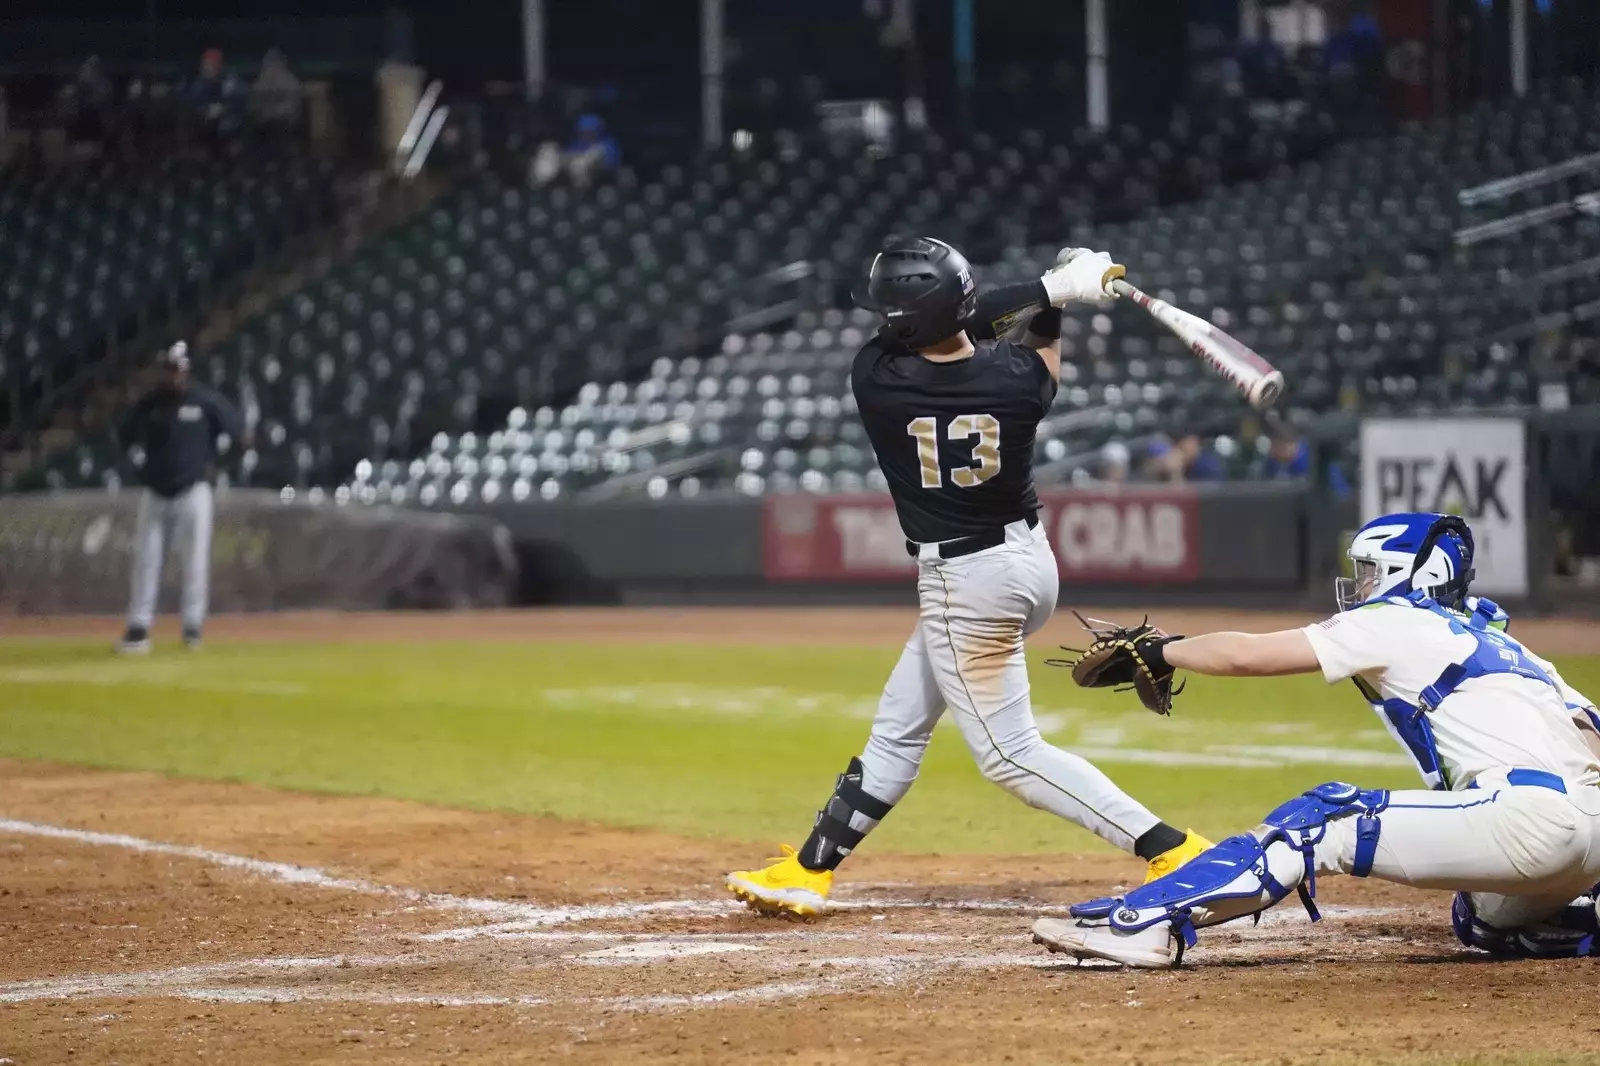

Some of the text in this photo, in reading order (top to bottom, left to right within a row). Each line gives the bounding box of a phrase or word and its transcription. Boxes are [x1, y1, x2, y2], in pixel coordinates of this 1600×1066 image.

[906, 413, 1001, 489] 13
[1377, 448, 1509, 522] PEAK
[833, 507, 917, 567] TH
[1059, 503, 1187, 568] CRAB
